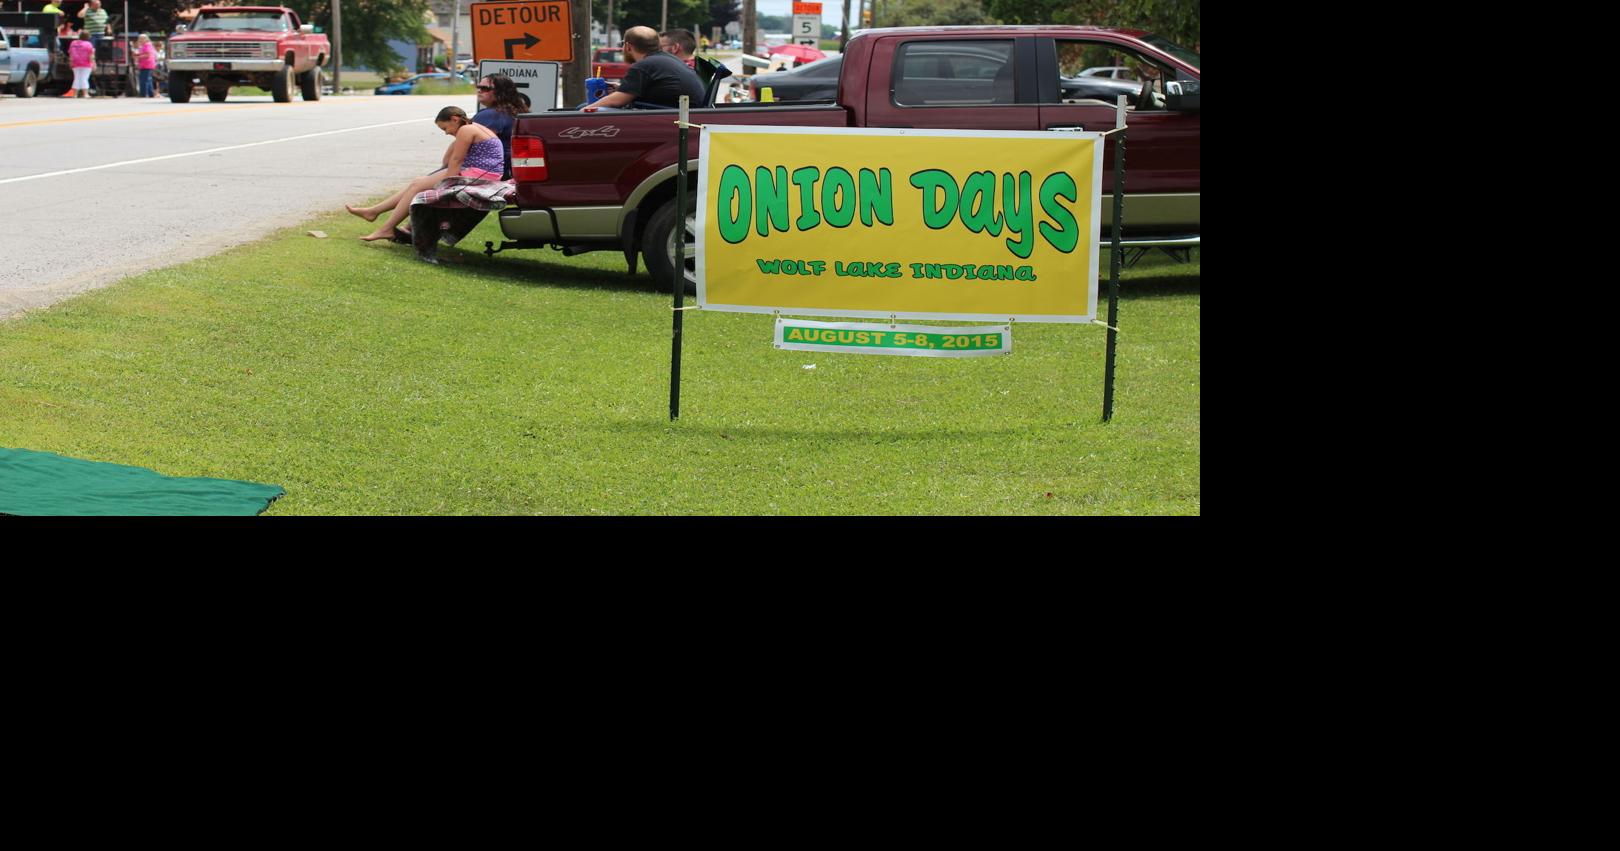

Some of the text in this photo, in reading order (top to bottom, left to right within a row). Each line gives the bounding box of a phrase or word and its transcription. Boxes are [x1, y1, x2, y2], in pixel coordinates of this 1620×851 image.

[480, 5, 560, 25] DETOUR
[802, 22, 811, 33] 5
[499, 67, 538, 78] INDIANA
[717, 163, 894, 244] ONION
[756, 258, 826, 276] WOLF
[787, 327, 999, 349] AUGUST 5-8, 2015
